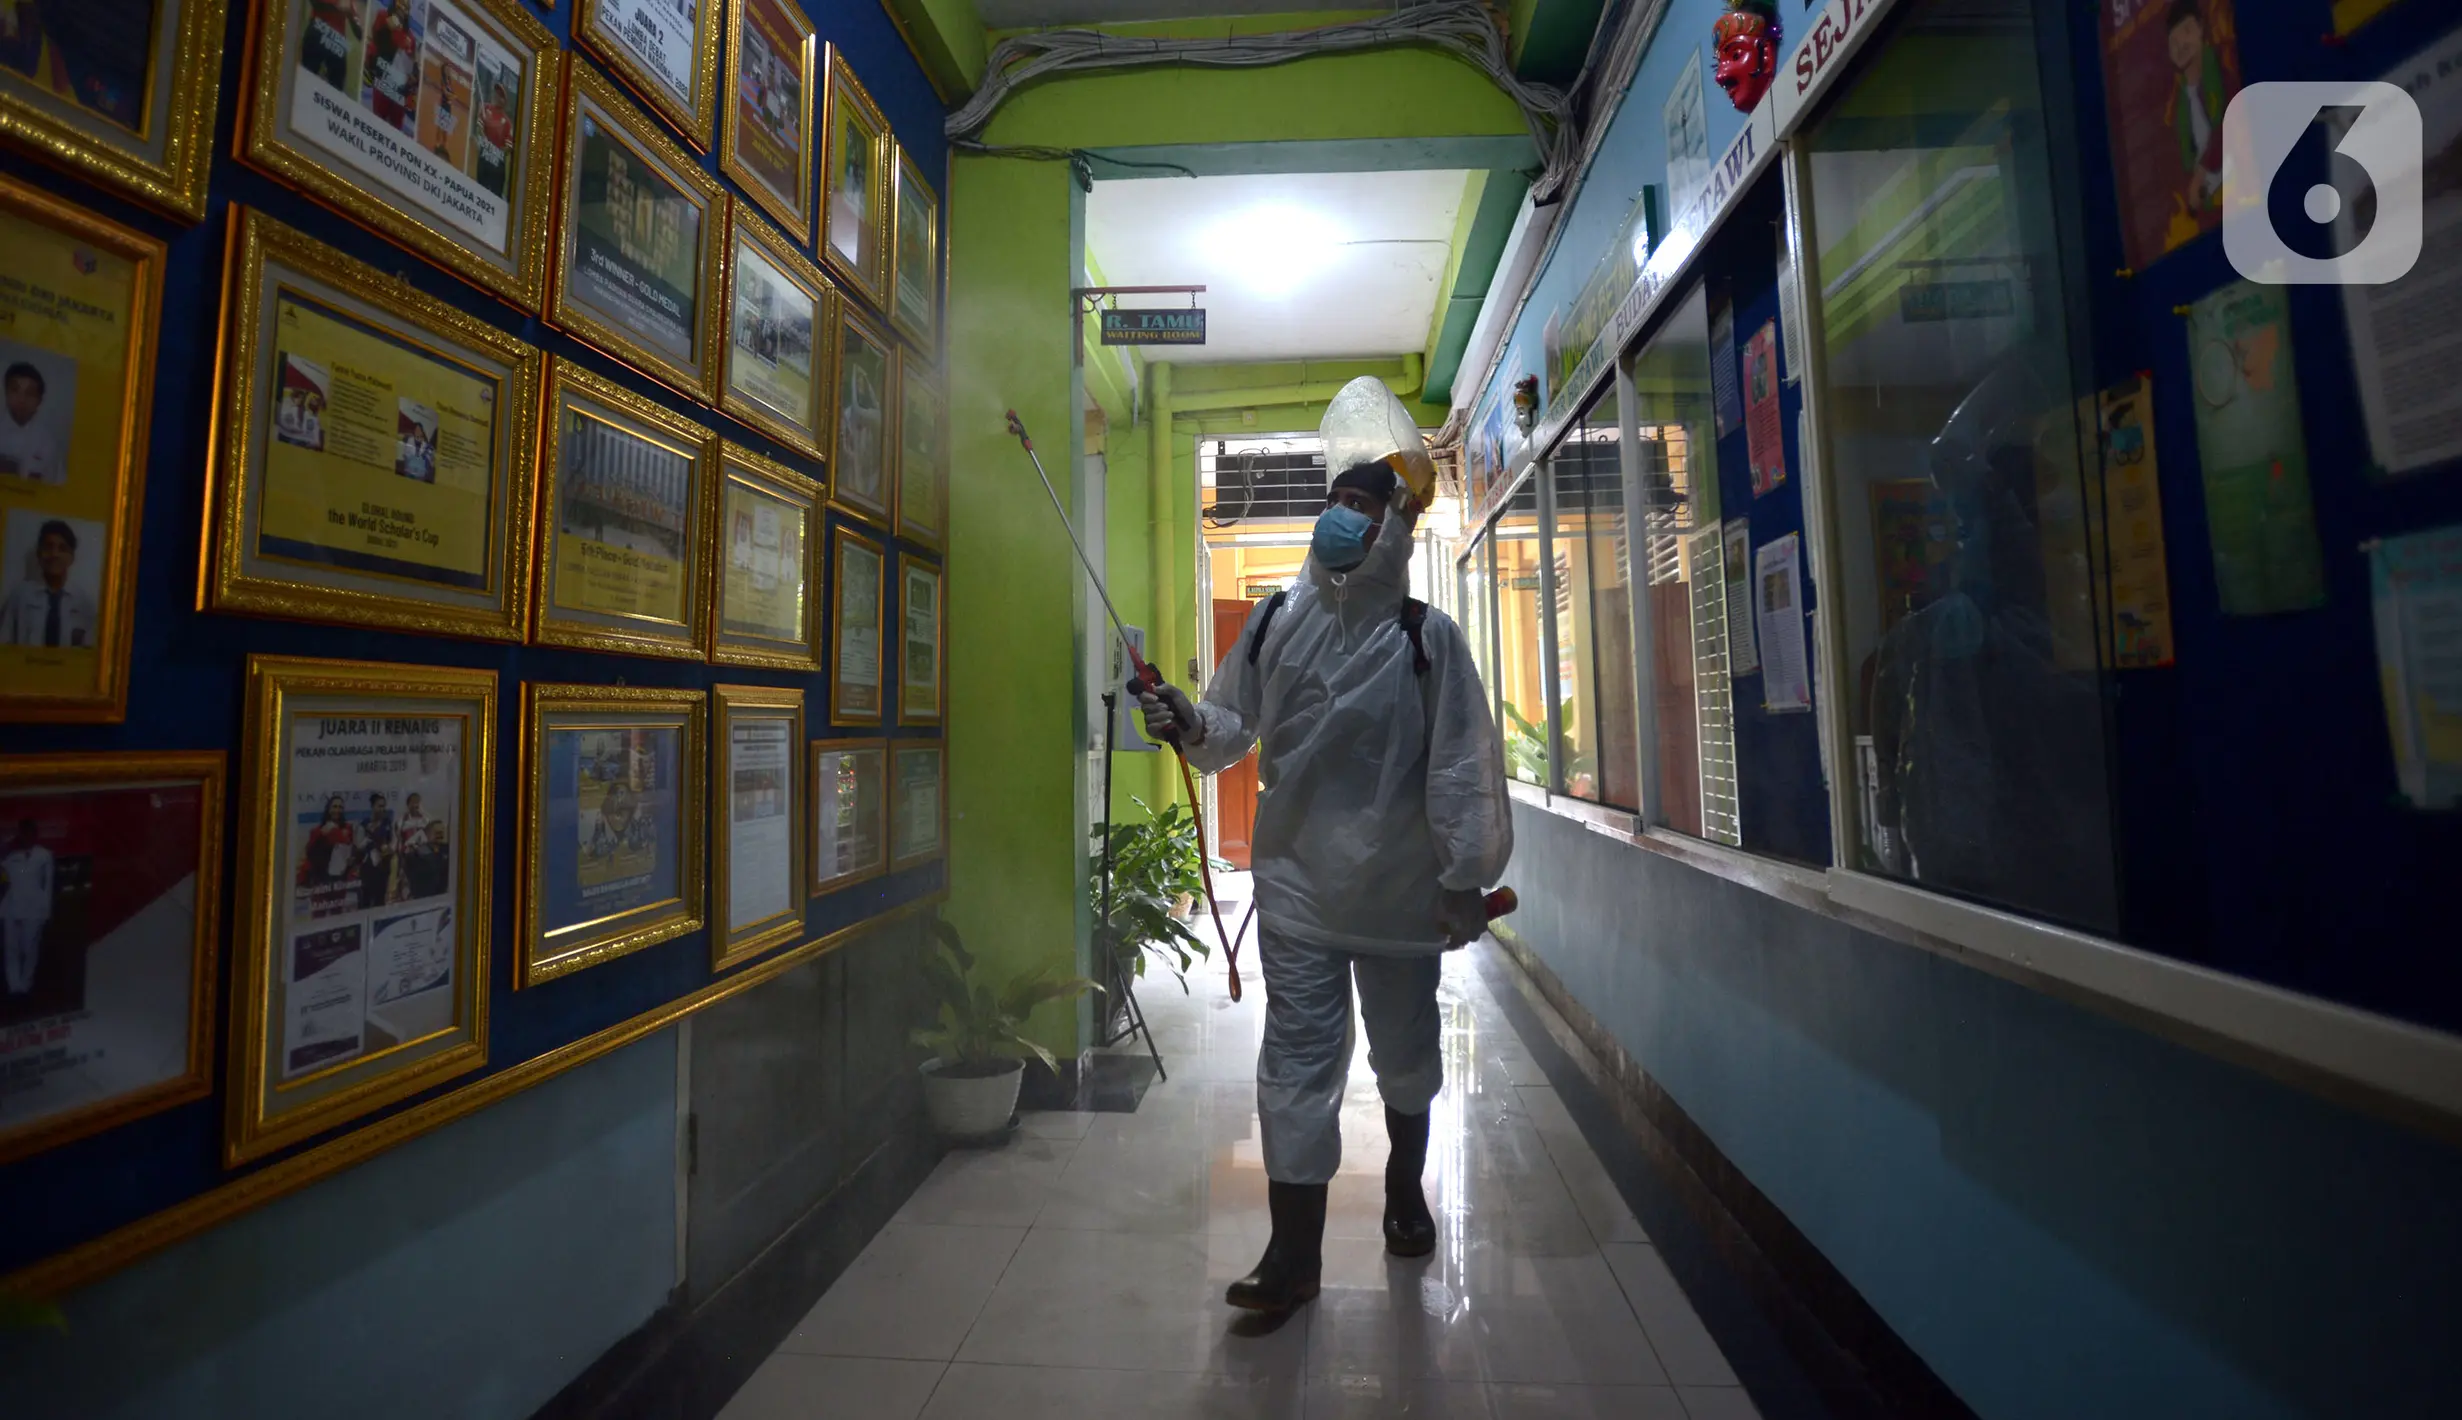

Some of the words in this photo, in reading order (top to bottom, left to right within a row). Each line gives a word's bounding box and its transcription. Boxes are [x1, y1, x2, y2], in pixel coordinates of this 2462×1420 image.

[634, 7, 657, 39] JUARA
[658, 29, 664, 46] 2
[313, 91, 350, 123] SISWA
[353, 117, 397, 152] PESERTA
[400, 147, 422, 169] PON
[424, 162, 438, 180] XX
[444, 174, 475, 202] PAPUA
[476, 196, 496, 217] 2021
[327, 118, 366, 154] WAKIL
[369, 146, 421, 186] PROVINSI
[423, 179, 441, 199] DKI
[441, 191, 484, 225] JAKARTA
[604, 256, 635, 288] WINNER
[639, 280, 659, 304] GOLD
[328, 508, 345, 525] the
[348, 512, 376, 532] World
[379, 518, 420, 541] Scholar's
[422, 528, 439, 548] Cup
[319, 719, 367, 739] JUARA
[385, 719, 440, 736] RENANG
[295, 746, 326, 758] PEKAN
